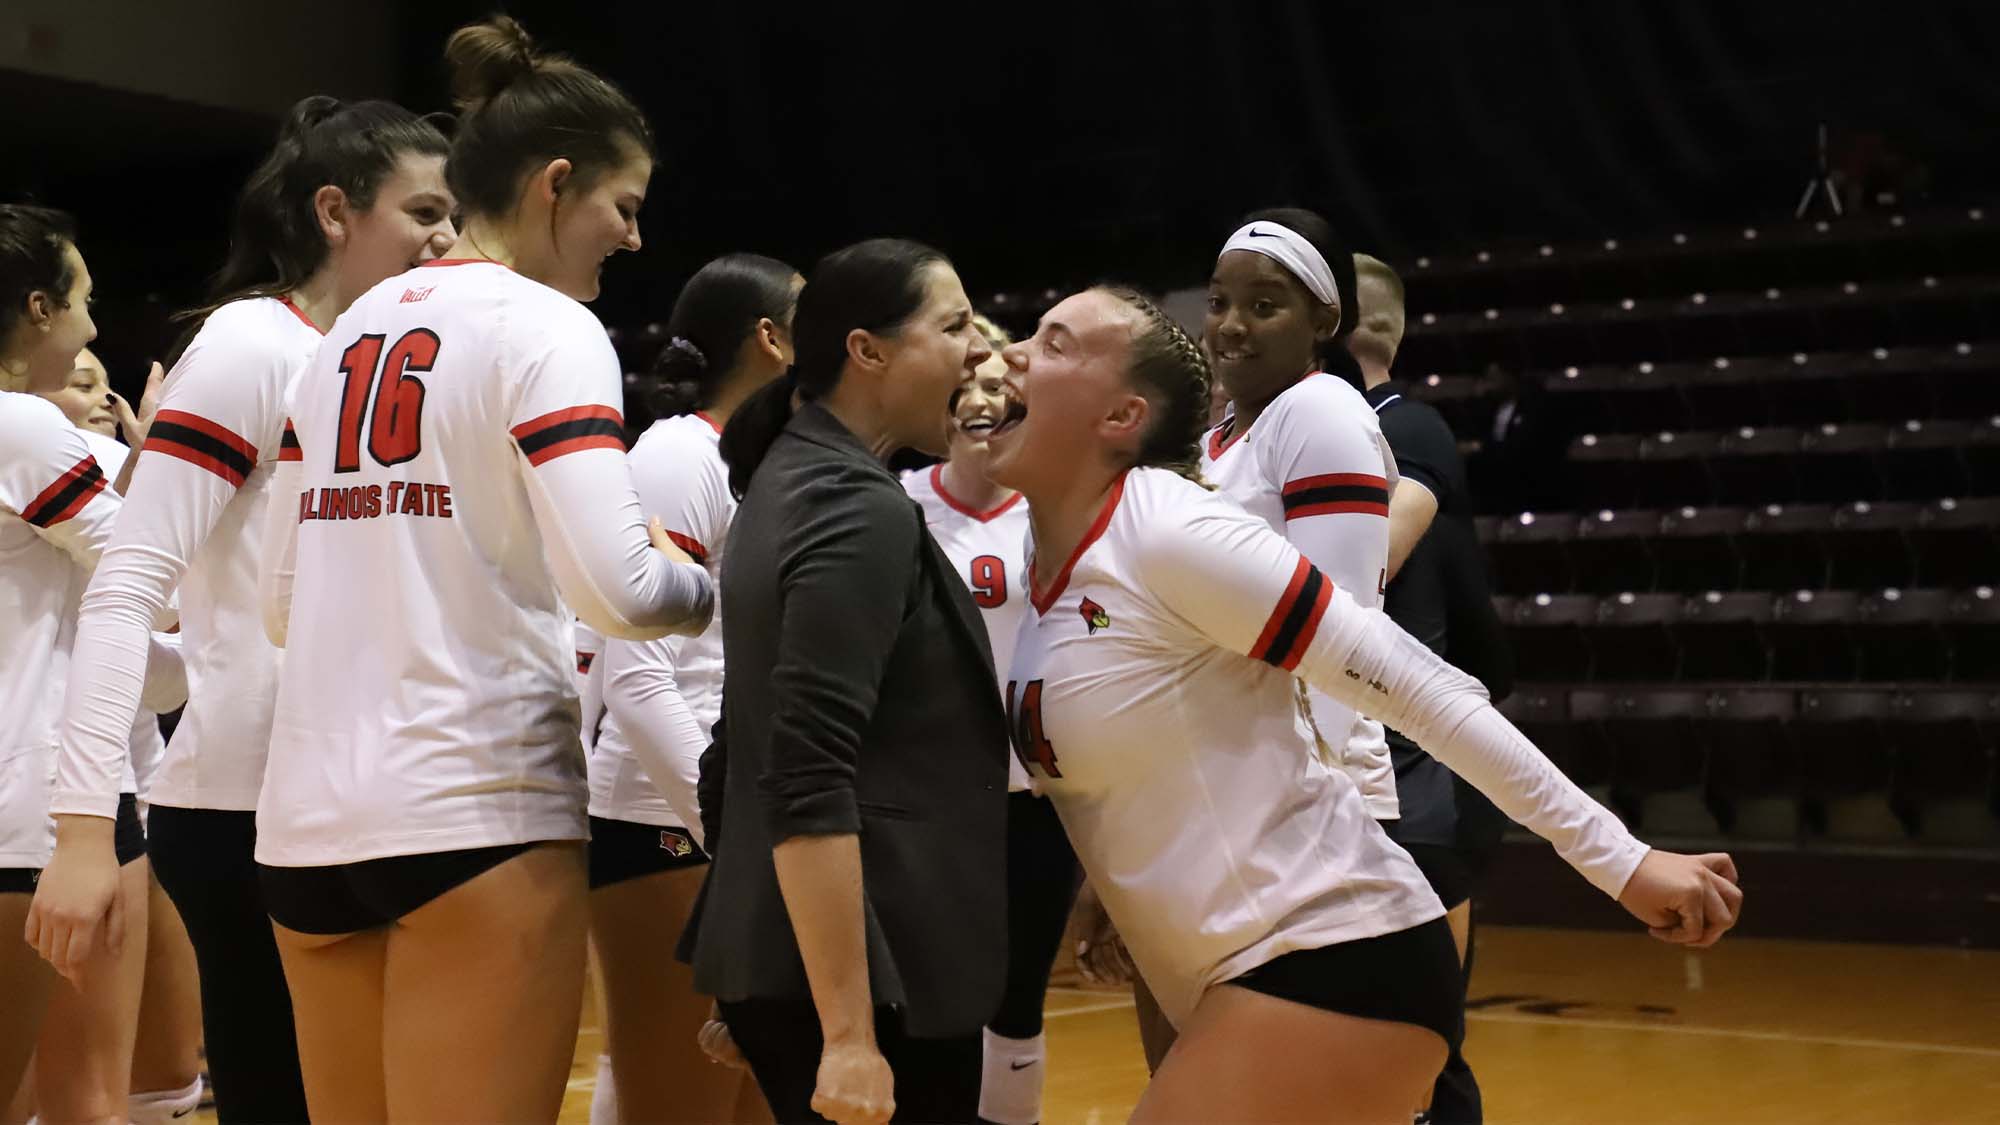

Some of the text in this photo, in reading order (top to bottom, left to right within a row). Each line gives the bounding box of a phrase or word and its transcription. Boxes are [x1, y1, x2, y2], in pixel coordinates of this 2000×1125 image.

[334, 327, 441, 473] 16
[299, 481, 453, 524] ILINOIS TATE
[970, 555, 1008, 609] 9
